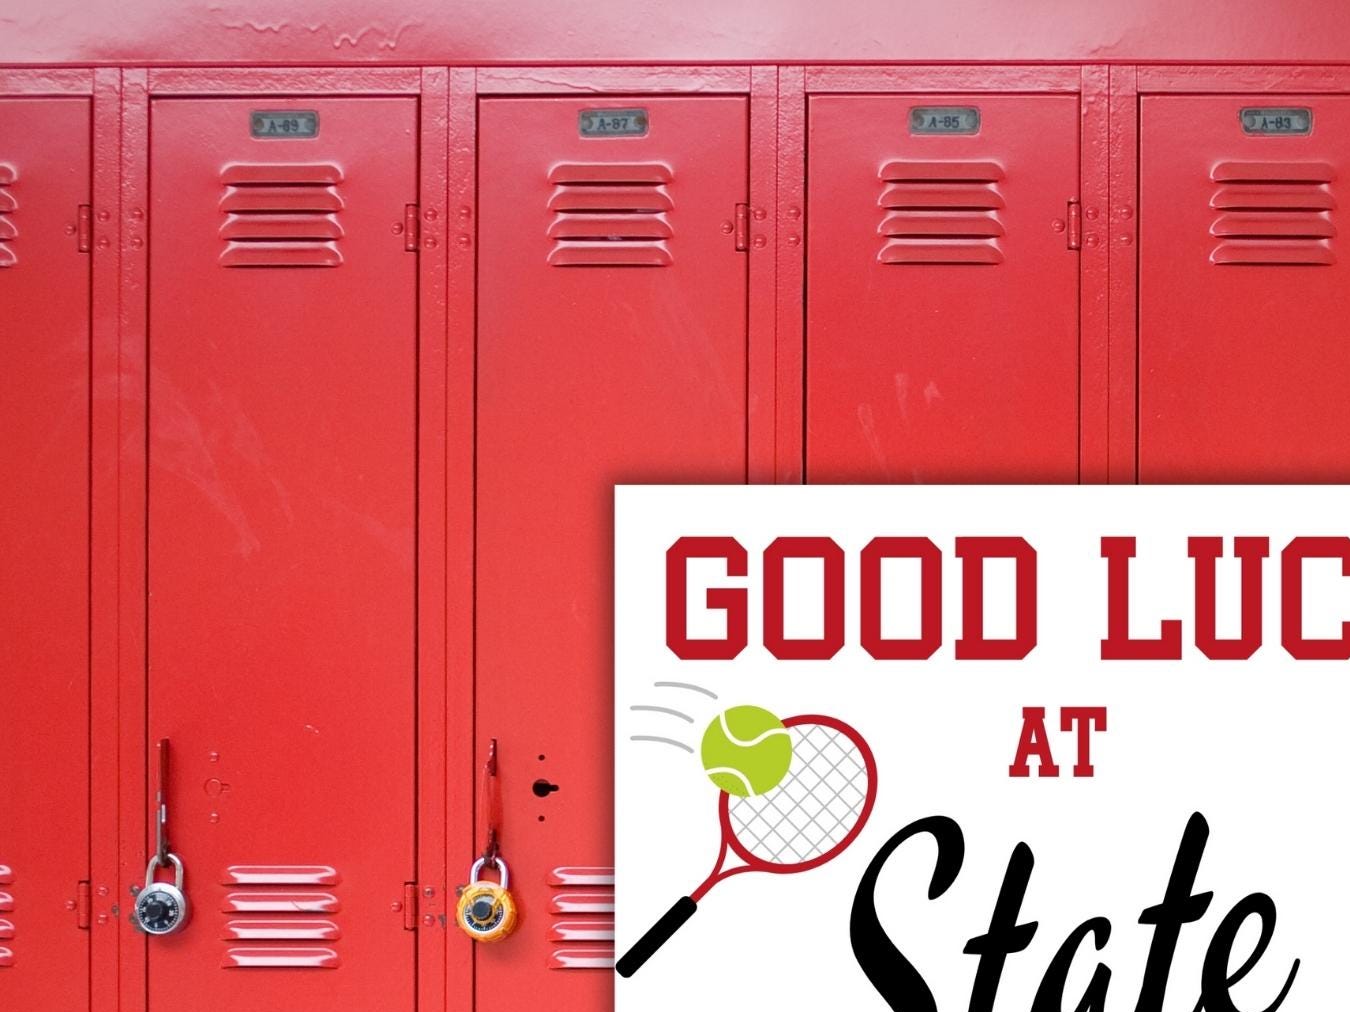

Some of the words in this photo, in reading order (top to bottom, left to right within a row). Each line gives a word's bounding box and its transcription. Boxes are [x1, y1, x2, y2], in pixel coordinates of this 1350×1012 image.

[597, 117, 628, 130] A-87
[928, 115, 960, 128] A-85
[1261, 117, 1292, 129] A-83
[666, 536, 1037, 661] GOOD
[1009, 706, 1107, 778] AT
